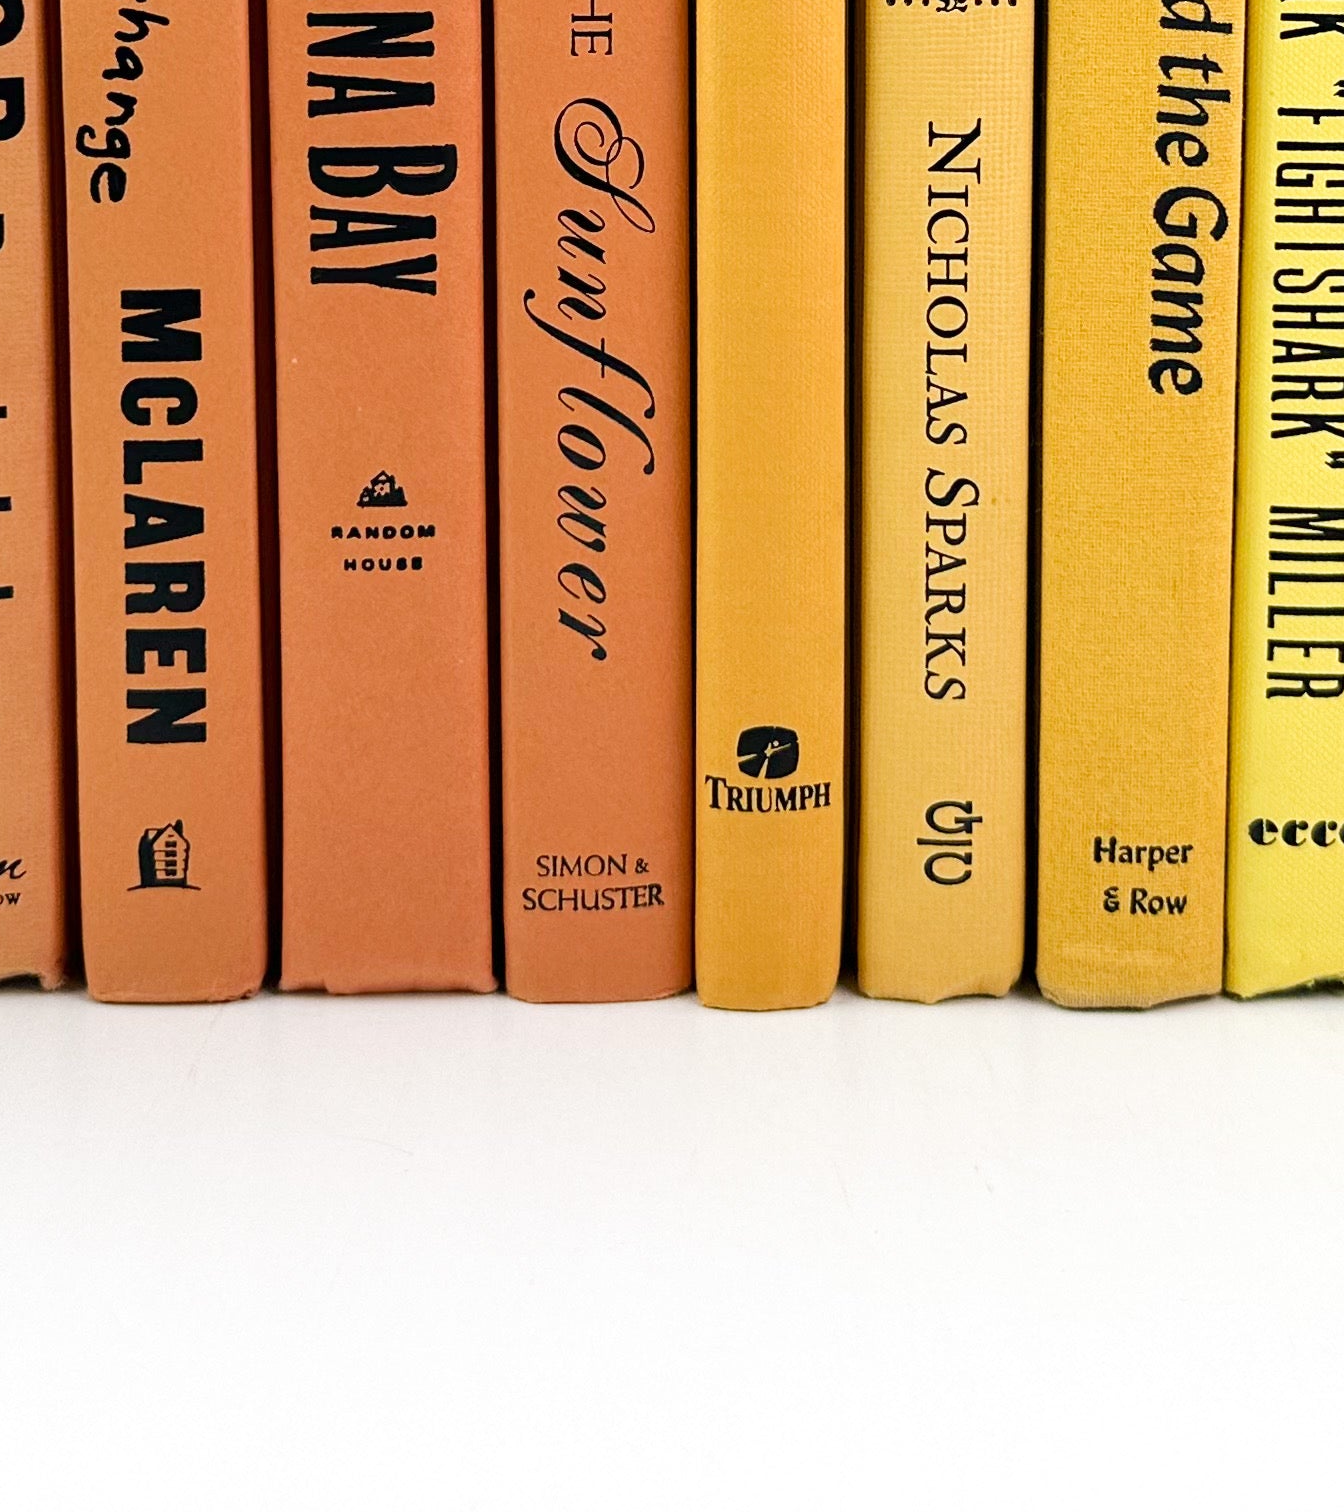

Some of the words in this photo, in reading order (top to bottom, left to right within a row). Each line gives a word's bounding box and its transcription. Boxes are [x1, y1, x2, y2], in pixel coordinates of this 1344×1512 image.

[1154, 53, 1232, 168] the
[307, 143, 458, 297] BAY
[924, 117, 982, 445] NICHOLAS
[1147, 186, 1229, 396] Game
[523, 97, 656, 661] Sunflower
[120, 288, 207, 745] MCLAREN
[331, 524, 436, 540] RANDOM
[343, 556, 423, 572] HOUSE
[924, 467, 980, 700] SPARKS
[704, 774, 831, 814] TRIUMPH
[536, 853, 628, 878] SIMON
[634, 857, 650, 875] &
[1093, 836, 1194, 873] Harper
[522, 883, 665, 912] SCHUSTER
[1103, 886, 1120, 914] &
[1129, 887, 1188, 916] Row
